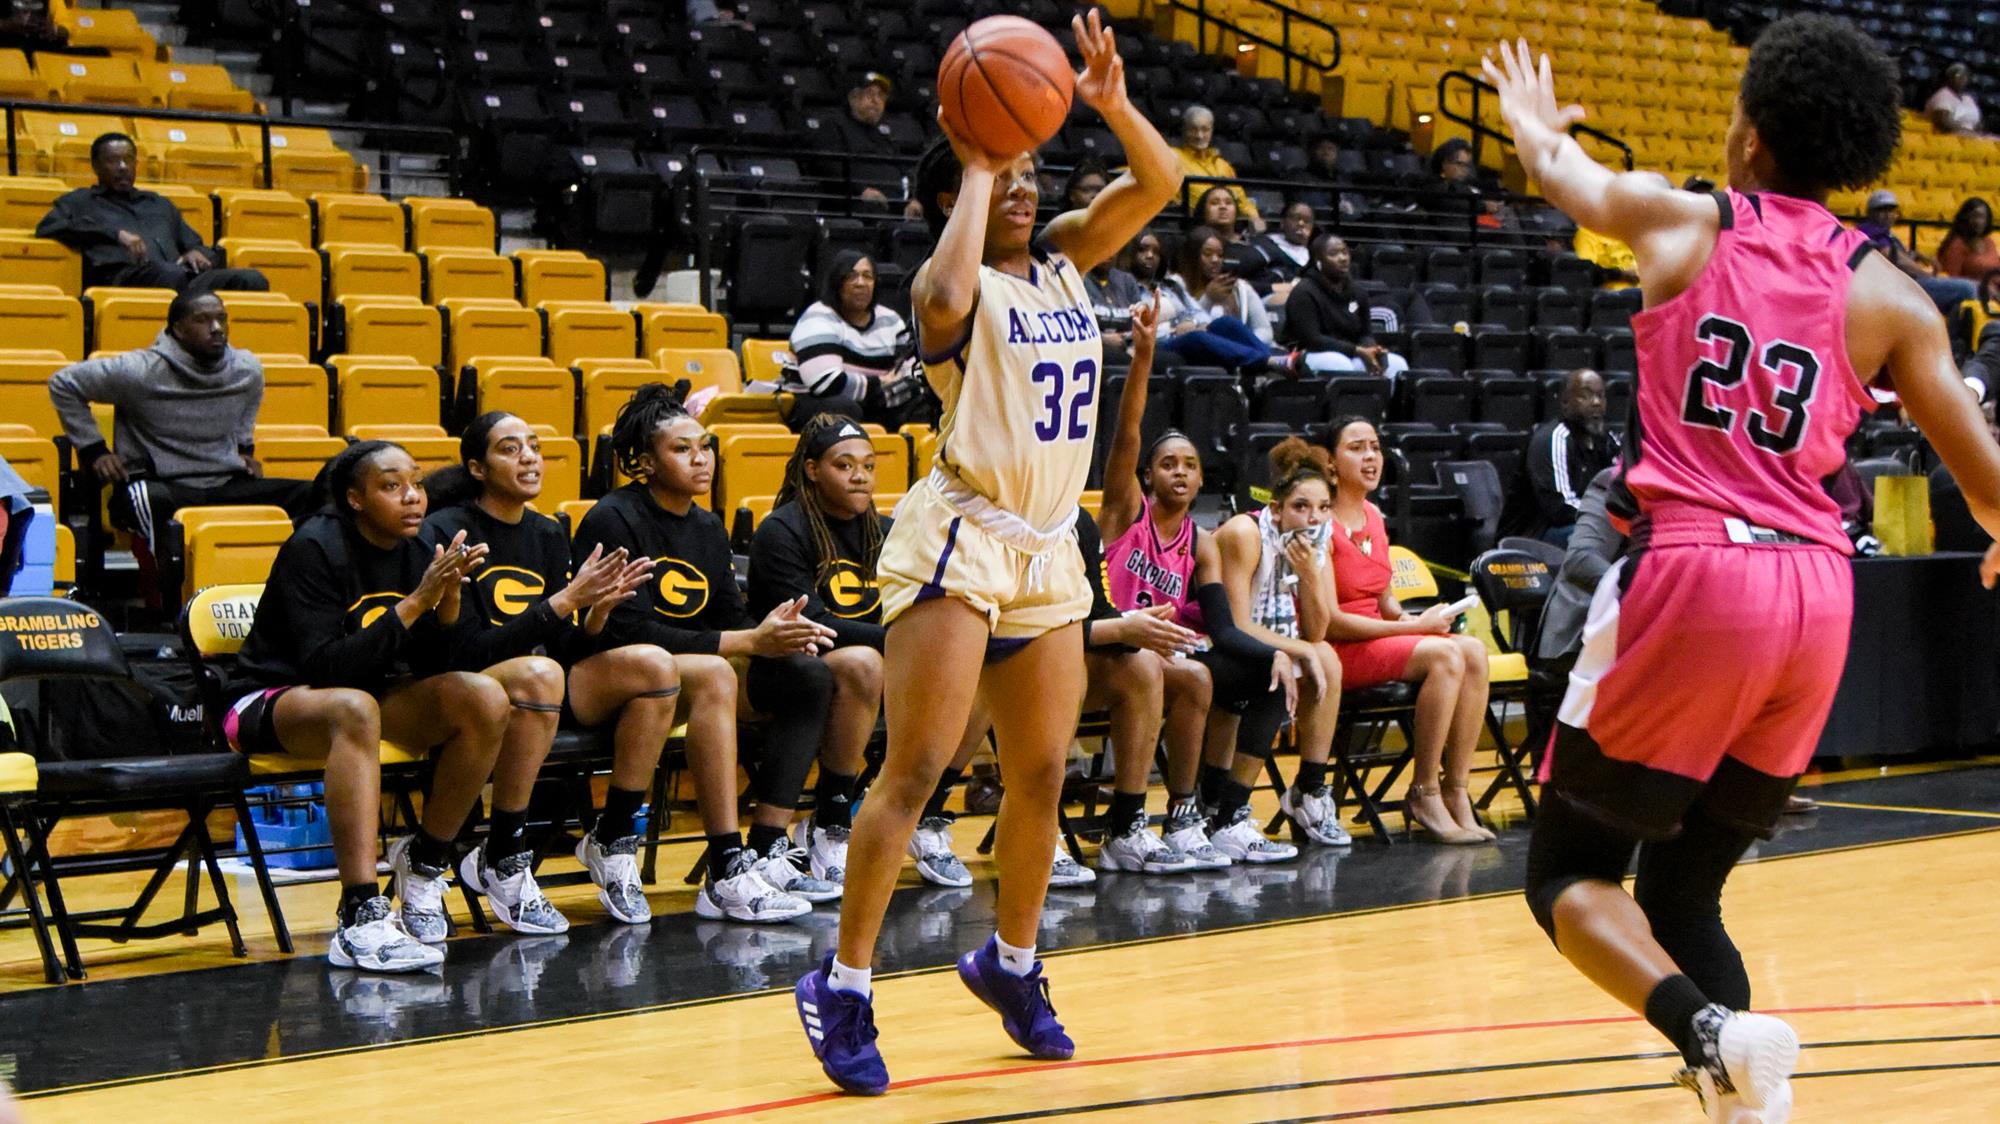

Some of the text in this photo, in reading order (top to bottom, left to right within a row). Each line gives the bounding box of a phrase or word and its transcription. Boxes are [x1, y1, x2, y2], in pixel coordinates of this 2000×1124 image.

[1031, 358, 1097, 442] 32
[1680, 312, 1822, 457] 23
[16, 632, 83, 650] TIGERS
[216, 622, 253, 639] VOL
